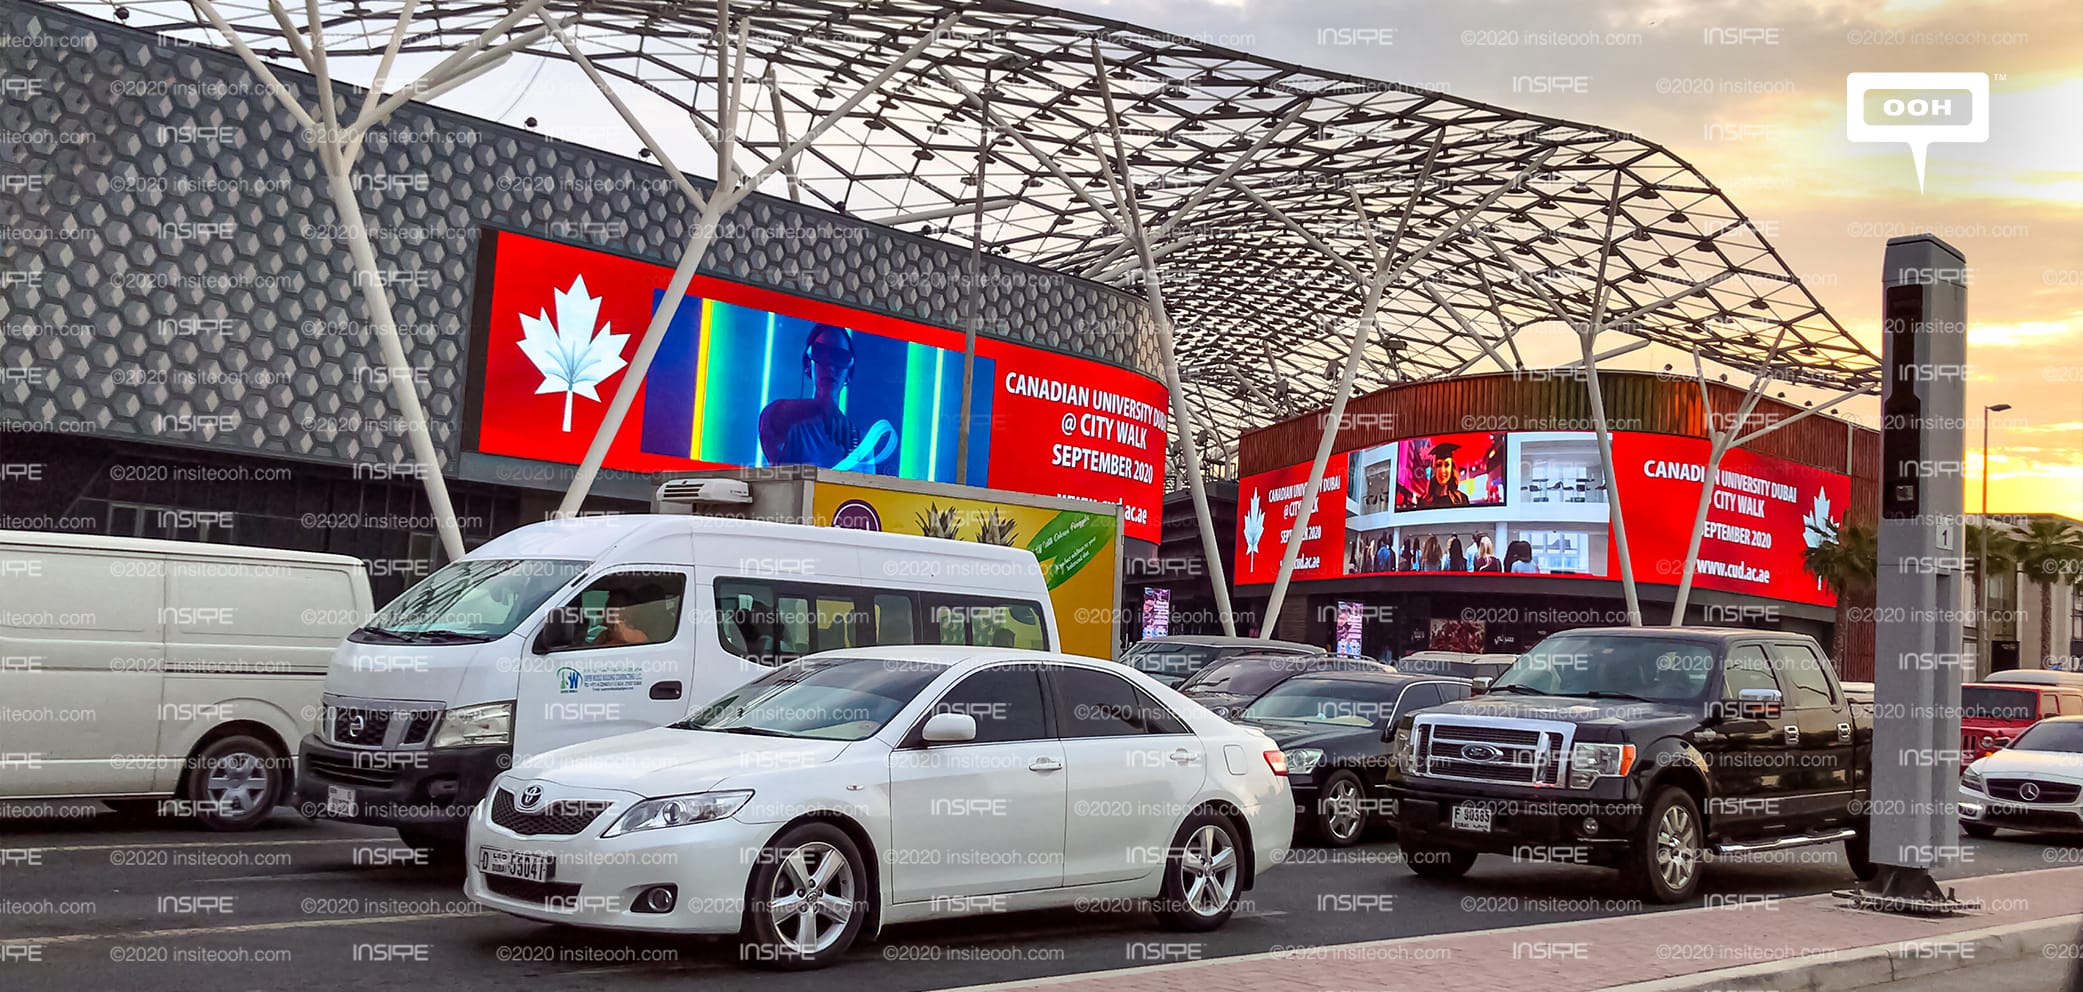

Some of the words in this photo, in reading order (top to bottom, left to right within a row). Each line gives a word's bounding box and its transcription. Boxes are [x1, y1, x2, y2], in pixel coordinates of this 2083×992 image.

[1005, 372, 1089, 408] CANADIAN
[1092, 390, 1153, 425] UNIVERSITY
[1061, 412, 1077, 436] @
[1080, 413, 1115, 441] CITY
[1116, 419, 1148, 450] WALK
[1051, 443, 1132, 479] SEPTEMBER
[1133, 459, 1154, 485] 2020
[1323, 475, 1341, 493] DUBAI
[1643, 460, 1719, 486] CANADIN
[1721, 469, 1770, 497] UNIVERSITY
[1771, 482, 1797, 504] DUBAI
[1713, 489, 1737, 512] CITY
[1737, 494, 1765, 518] WALK
[1308, 525, 1321, 540] 2020
[1702, 520, 1751, 546] EPTEMBER
[1751, 529, 1772, 550] 2020
[1942, 529, 1948, 546] 1
[1696, 558, 1770, 583] www.cud.ac.ae
